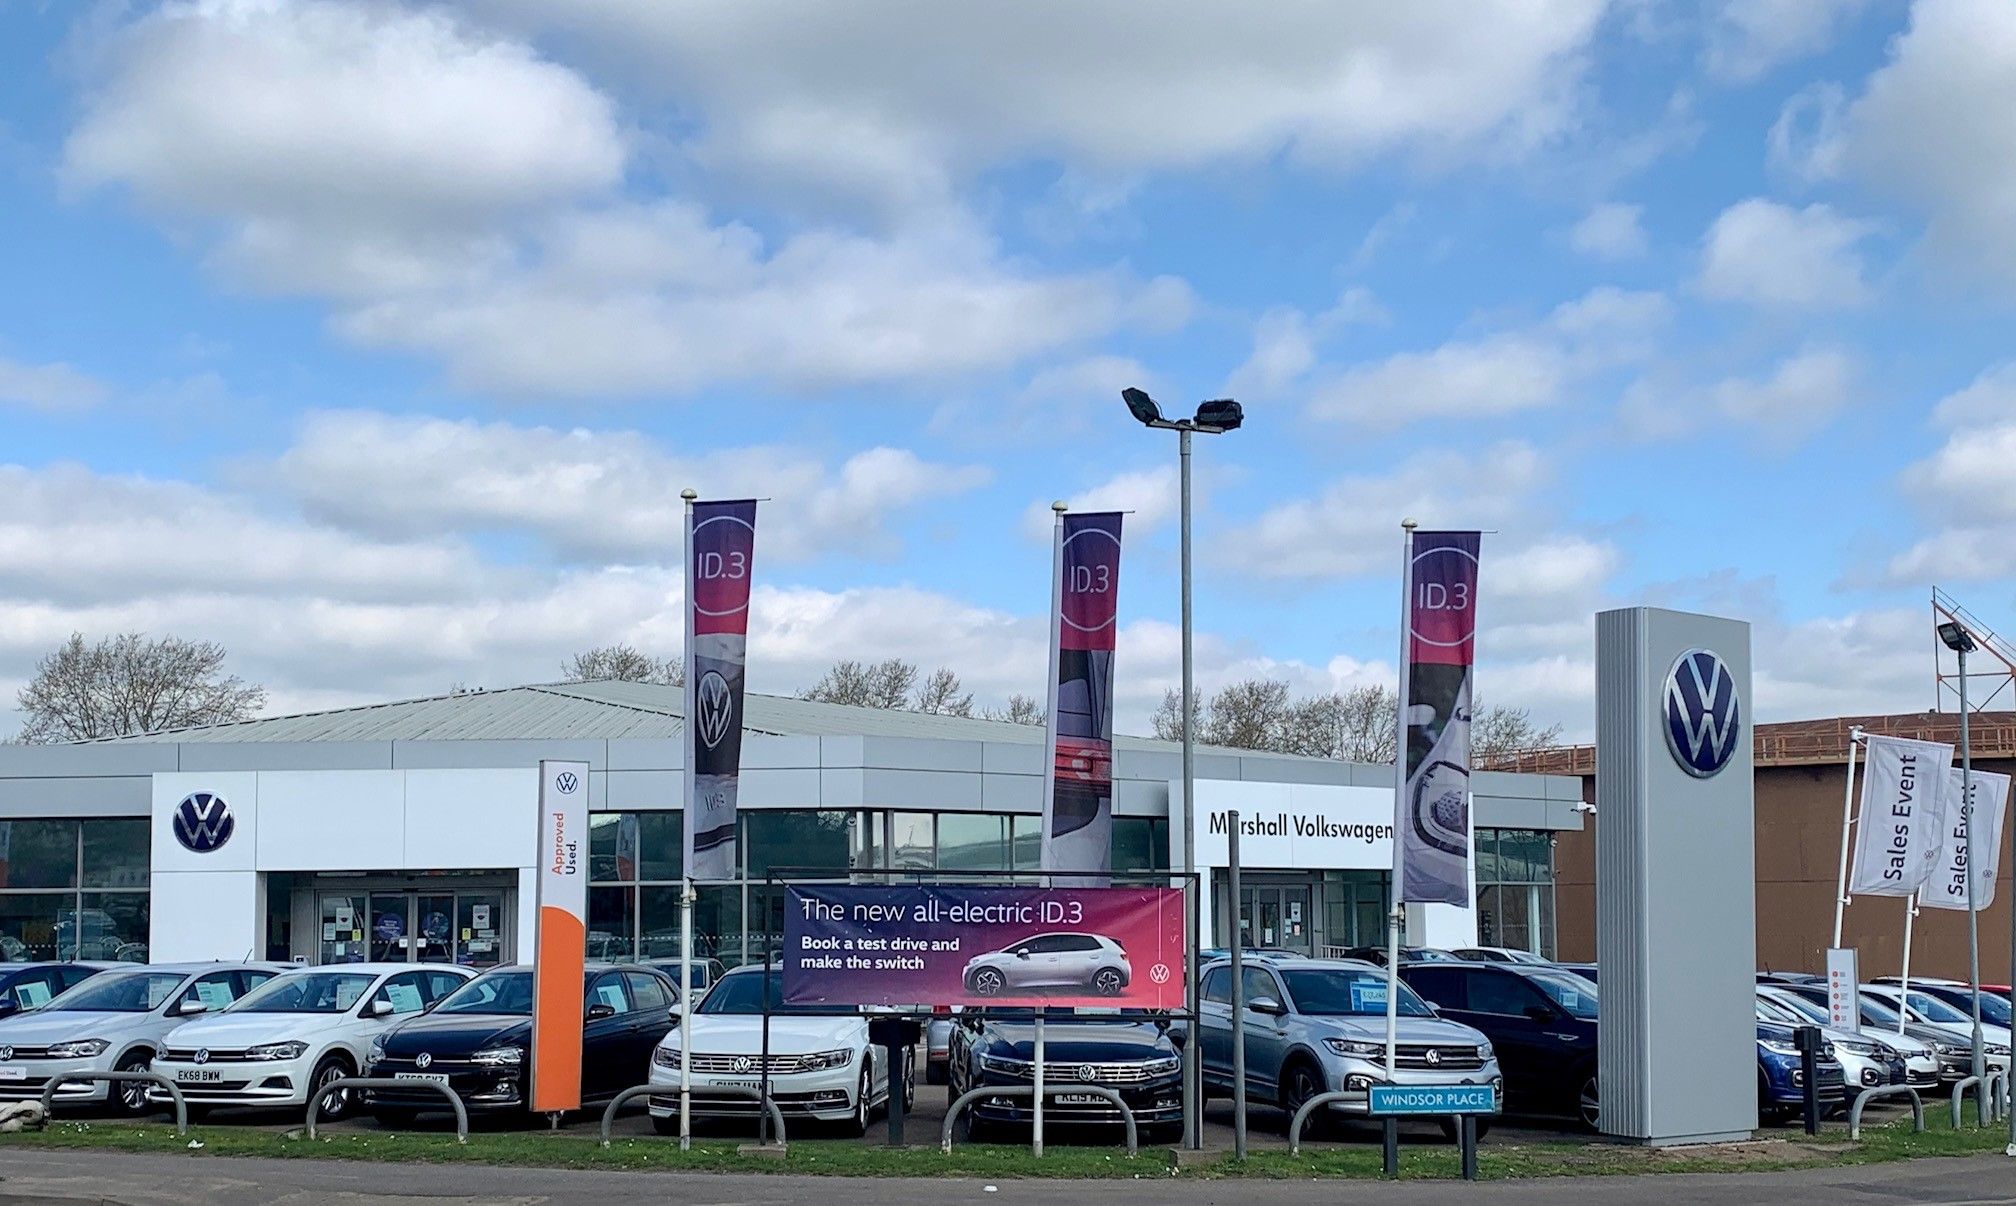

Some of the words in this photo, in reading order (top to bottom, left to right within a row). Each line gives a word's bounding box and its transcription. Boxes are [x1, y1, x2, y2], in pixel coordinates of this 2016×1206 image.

[698, 552, 745, 579] ID.3
[1070, 565, 1109, 593] ID.3
[1419, 583, 1468, 610] ID.3
[1892, 754, 1917, 818] Event
[1209, 811, 1288, 837] Mrshall
[1292, 814, 1394, 844] Volkswagen
[552, 812, 565, 875] Approved
[1884, 824, 1909, 880] Sales
[565, 840, 577, 875] Used.
[800, 898, 845, 921] The
[853, 904, 906, 921] new
[913, 899, 1033, 924] all-electric
[1040, 901, 1083, 924] ID.3
[801, 936, 840, 950] Book
[843, 939, 854, 950] a
[857, 938, 888, 951] test
[890, 937, 928, 951] drive
[931, 938, 960, 951] and
[800, 955, 842, 969] make
[846, 955, 871, 969] the
[875, 955, 925, 969] switch
[1382, 1094, 1443, 1106] WINDSOR
[1447, 1093, 1484, 1106] PLACE
